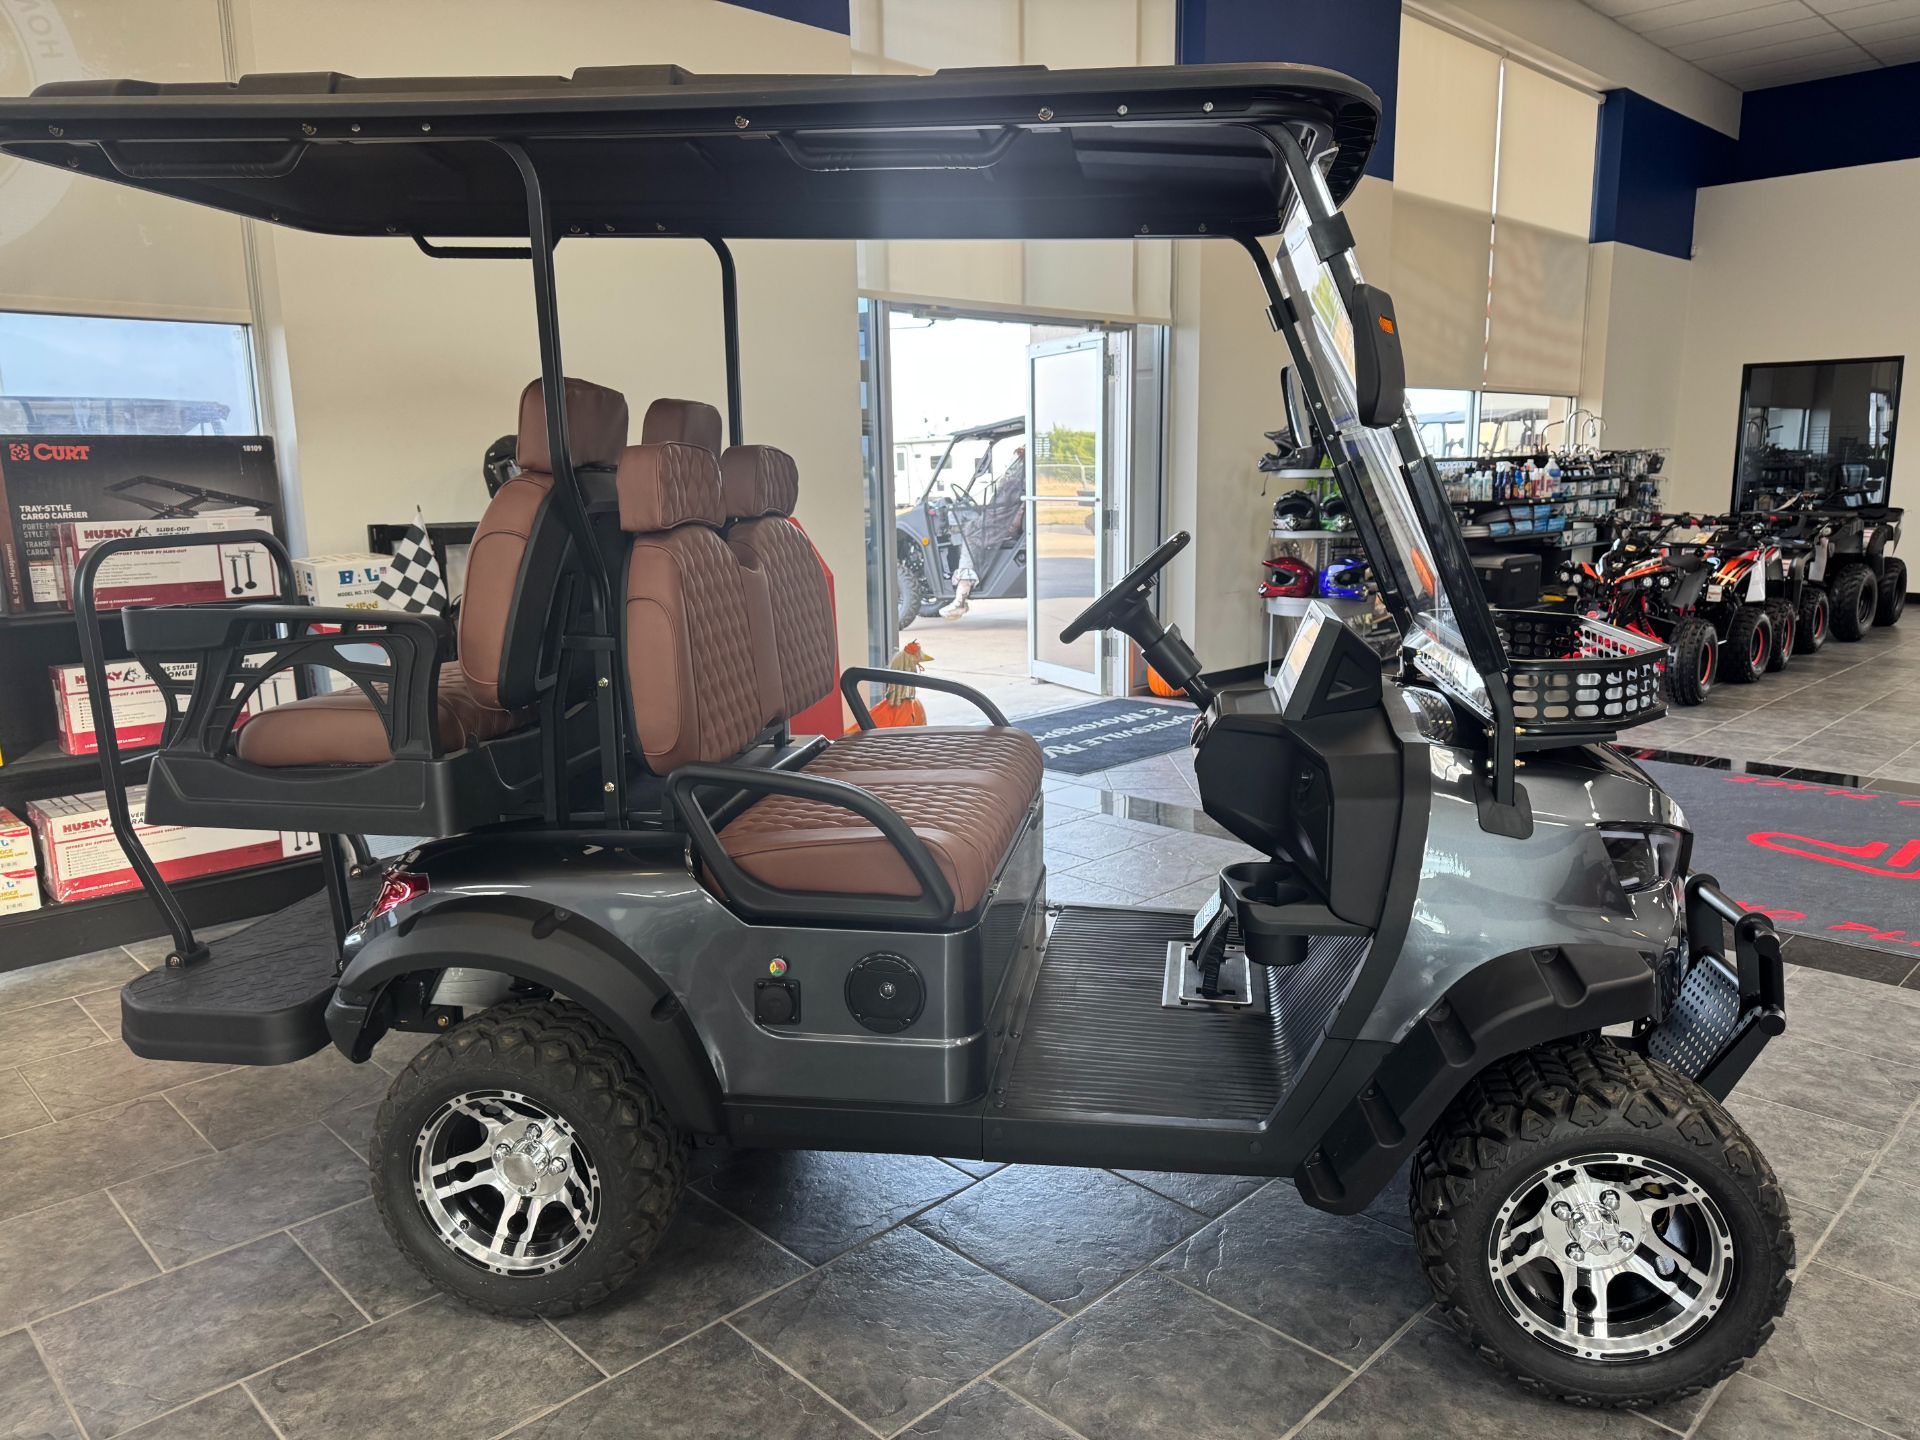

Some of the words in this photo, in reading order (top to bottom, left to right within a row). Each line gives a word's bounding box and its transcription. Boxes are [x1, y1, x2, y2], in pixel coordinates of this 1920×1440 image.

[33, 443, 90, 461] CURT
[242, 444, 263, 453] 18109
[19, 504, 72, 513] TRAY-STYLE
[20, 512, 50, 521] CARGO
[51, 510, 89, 520] CARRIER
[84, 527, 133, 540] HUSKY
[62, 817, 109, 834] HUSKY
